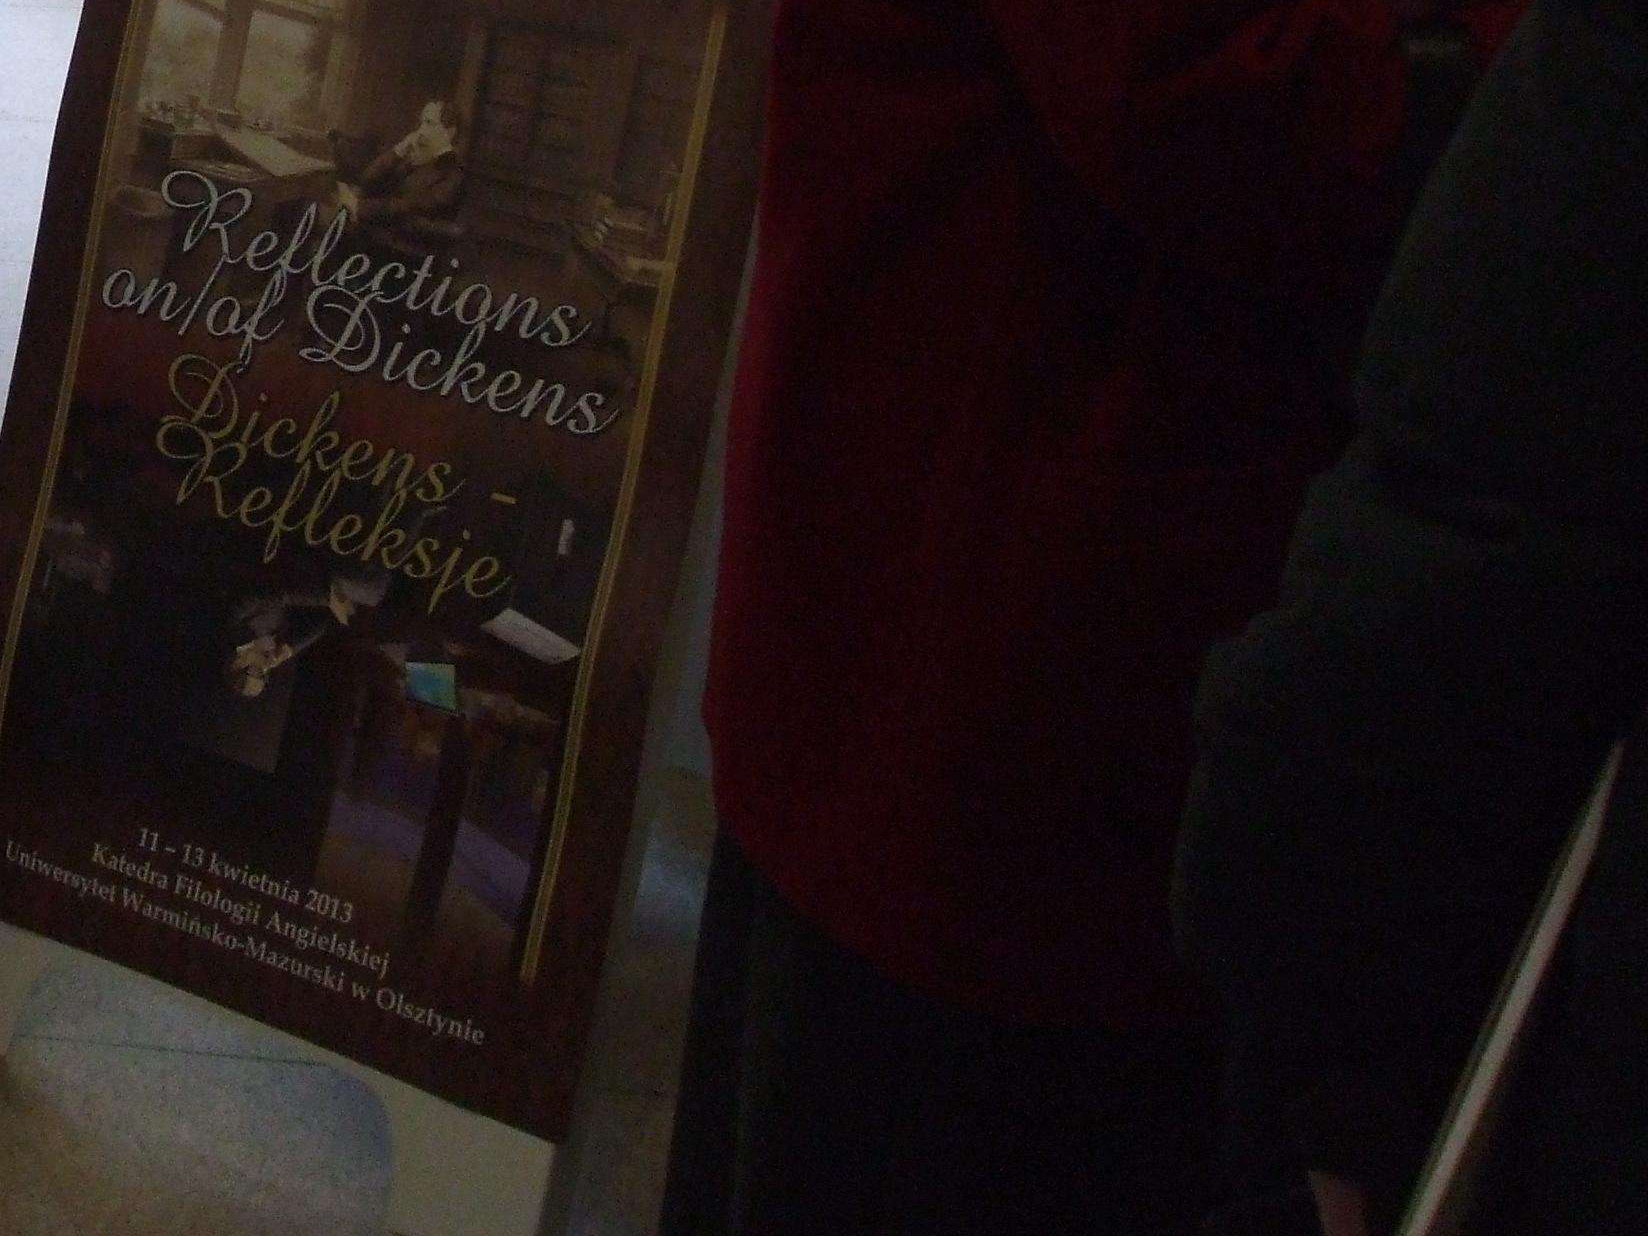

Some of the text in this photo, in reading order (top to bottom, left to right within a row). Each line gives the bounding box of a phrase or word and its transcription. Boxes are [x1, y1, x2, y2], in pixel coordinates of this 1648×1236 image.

[101, 257, 620, 433] on/of Dickens
[160, 170, 591, 346] Reflections
[159, 354, 465, 502] Dickens
[156, 421, 512, 613] Refleksje
[5, 839, 487, 1046] Uniwersytet Warmińsko-Mazurski w Olsztynie
[91, 842, 391, 980] Katedra Filologii Angielskiej
[138, 827, 160, 852] 11
[182, 844, 205, 868] 13
[208, 852, 300, 905] kwietnia
[304, 889, 353, 923] 2013
